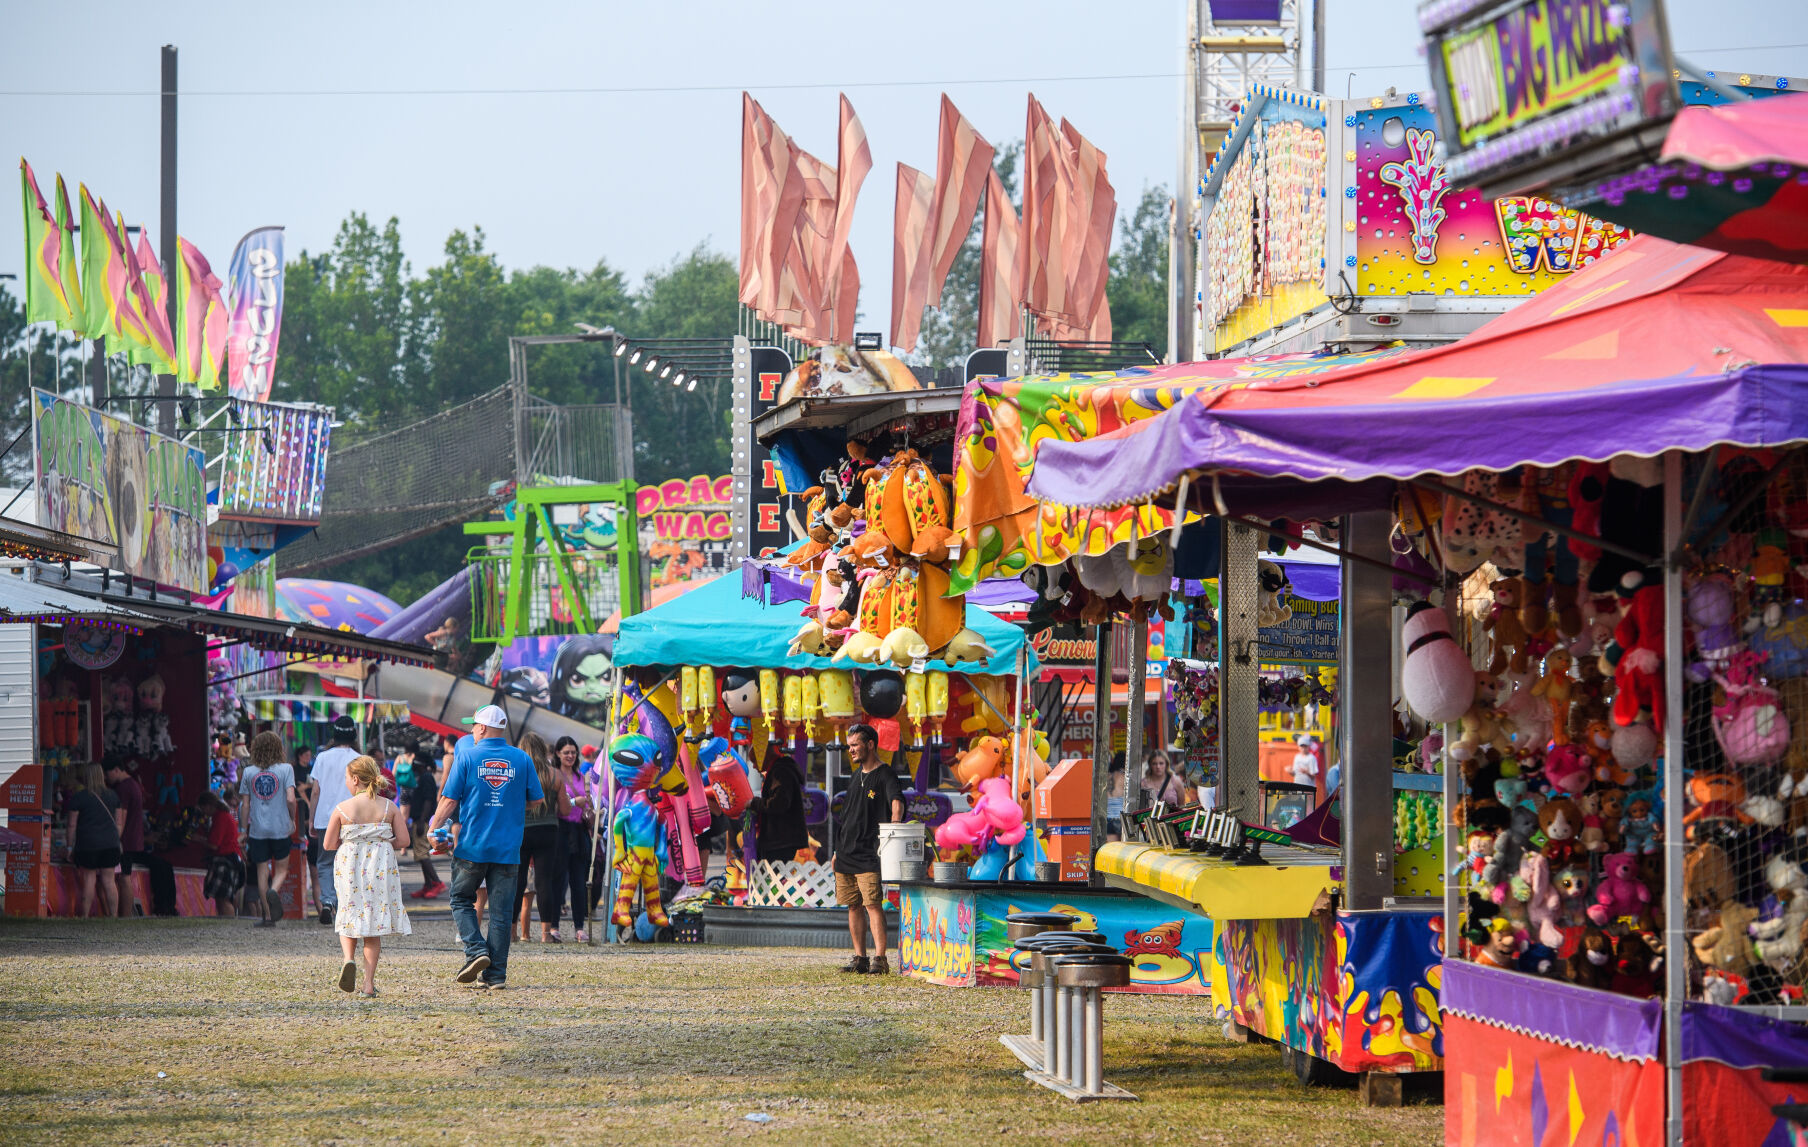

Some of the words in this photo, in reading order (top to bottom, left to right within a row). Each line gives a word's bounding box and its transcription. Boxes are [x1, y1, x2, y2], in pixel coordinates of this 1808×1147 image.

[652, 511, 733, 541] WAG
[1292, 618, 1313, 630] BOWL
[1315, 618, 1334, 631] Wins
[1282, 632, 1307, 645] Throw
[1315, 633, 1329, 646] Ball
[1290, 647, 1303, 658] ish
[1312, 649, 1335, 660] Starter
[1062, 710, 1119, 724] ELOD
[1063, 726, 1093, 740] HER
[480, 767, 514, 778] IRONCLAD
[9, 796, 35, 804] HERE
[670, 830, 684, 874] CRAYON
